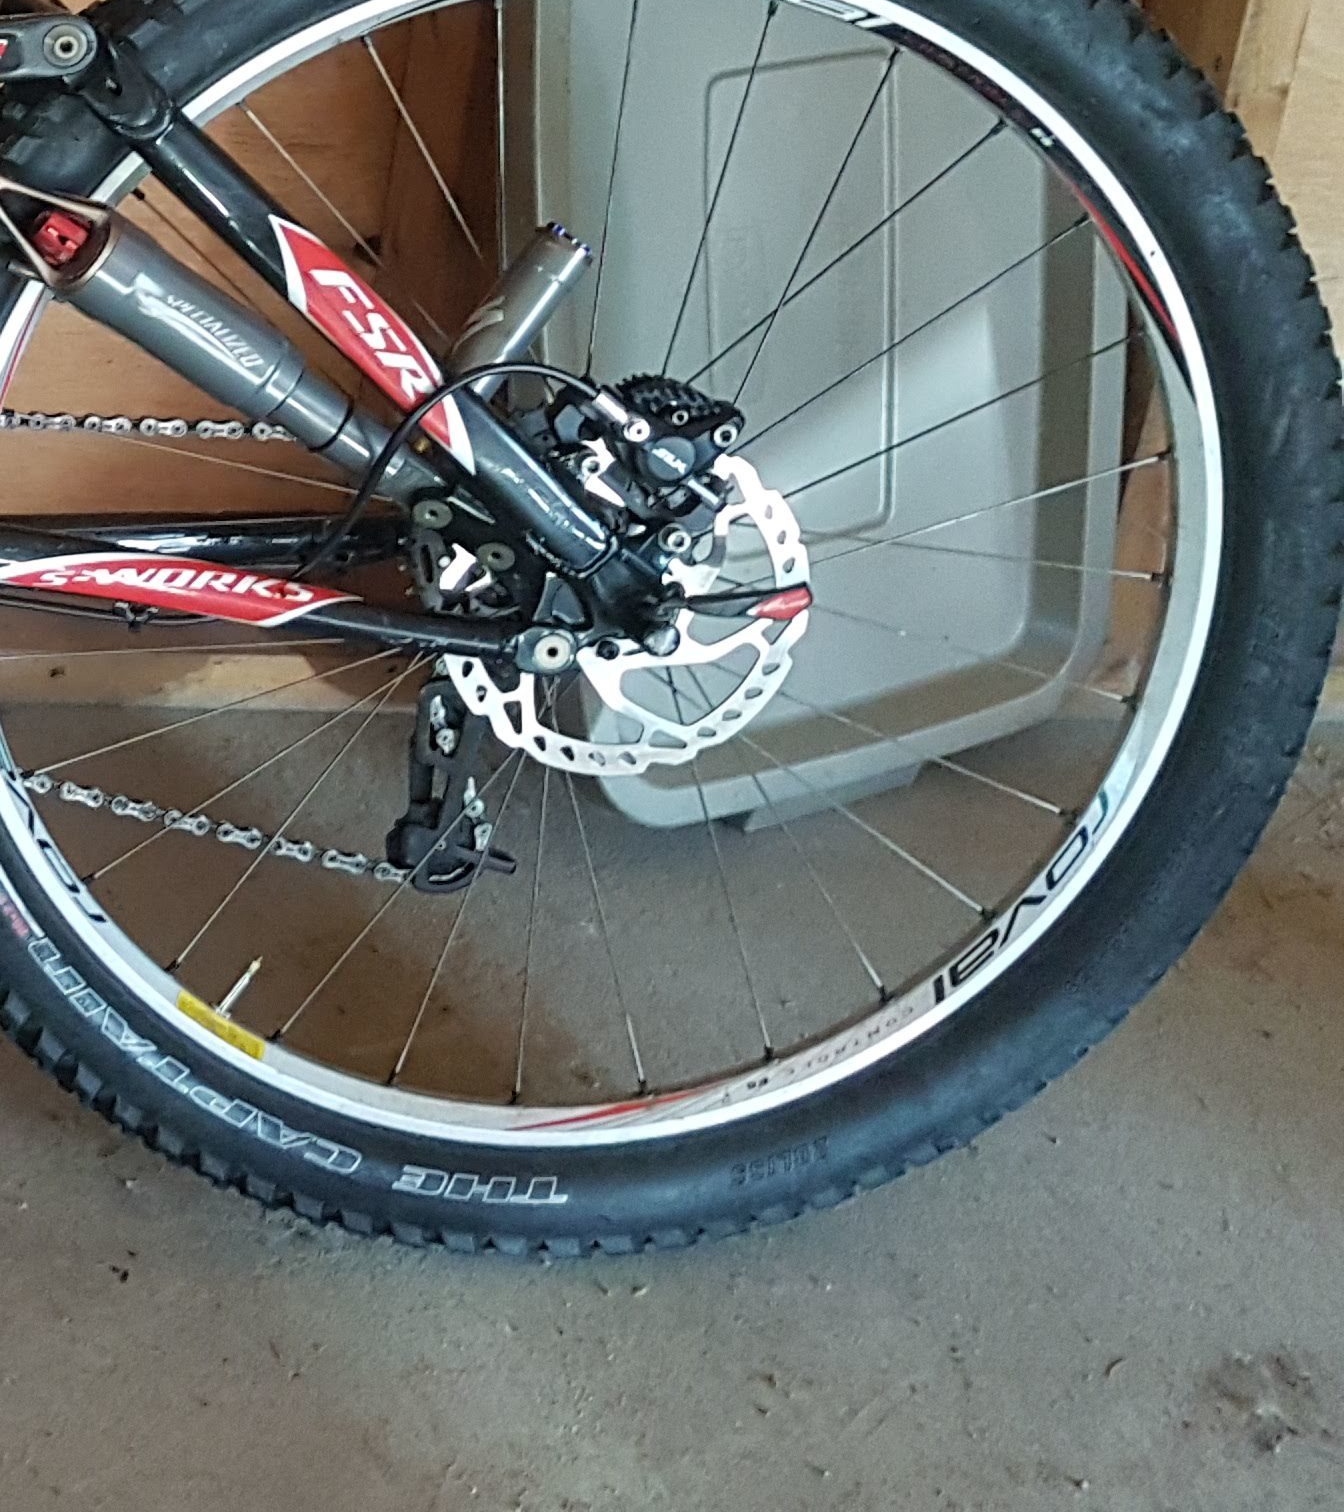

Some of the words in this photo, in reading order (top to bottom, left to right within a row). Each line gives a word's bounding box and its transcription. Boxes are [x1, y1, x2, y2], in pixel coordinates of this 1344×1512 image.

[306, 267, 435, 401] FSR
[33, 564, 319, 605] S-WORKS
[930, 789, 1110, 1009] roval
[25, 934, 364, 1176] CAPTAIN
[391, 1163, 570, 1206] THE
